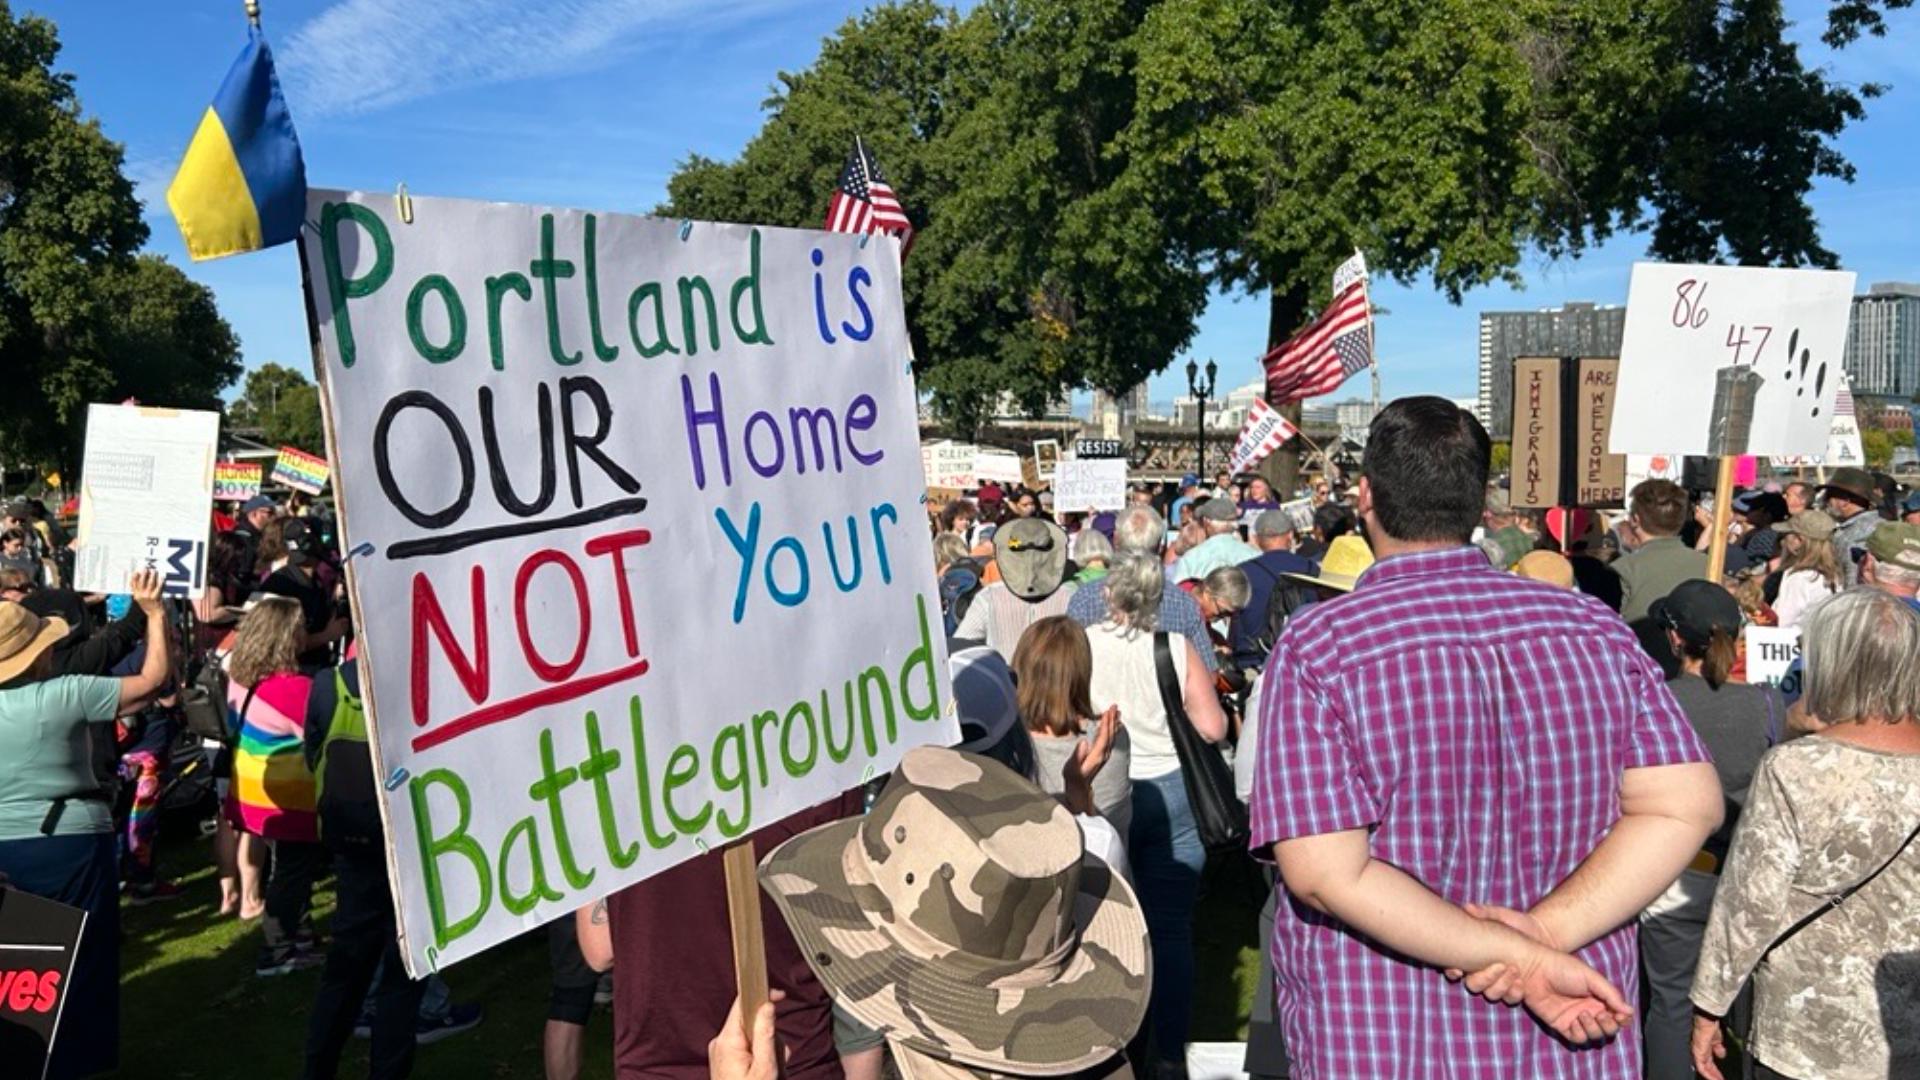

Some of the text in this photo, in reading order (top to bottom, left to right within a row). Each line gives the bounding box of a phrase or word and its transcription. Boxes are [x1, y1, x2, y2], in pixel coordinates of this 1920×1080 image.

[320, 202, 874, 370] Portland is
[1672, 279, 1710, 328] 86
[1727, 323, 1773, 366] 47
[1585, 369, 1614, 386] ARE
[374, 371, 883, 528] OUR Home
[1077, 440, 1119, 455] RESIST
[1589, 392, 1605, 483] WELCOME
[214, 481, 258, 496] BOYS
[1581, 487, 1621, 502] HERE
[411, 502, 898, 726] NOT Your
[409, 593, 940, 950] Battleground
